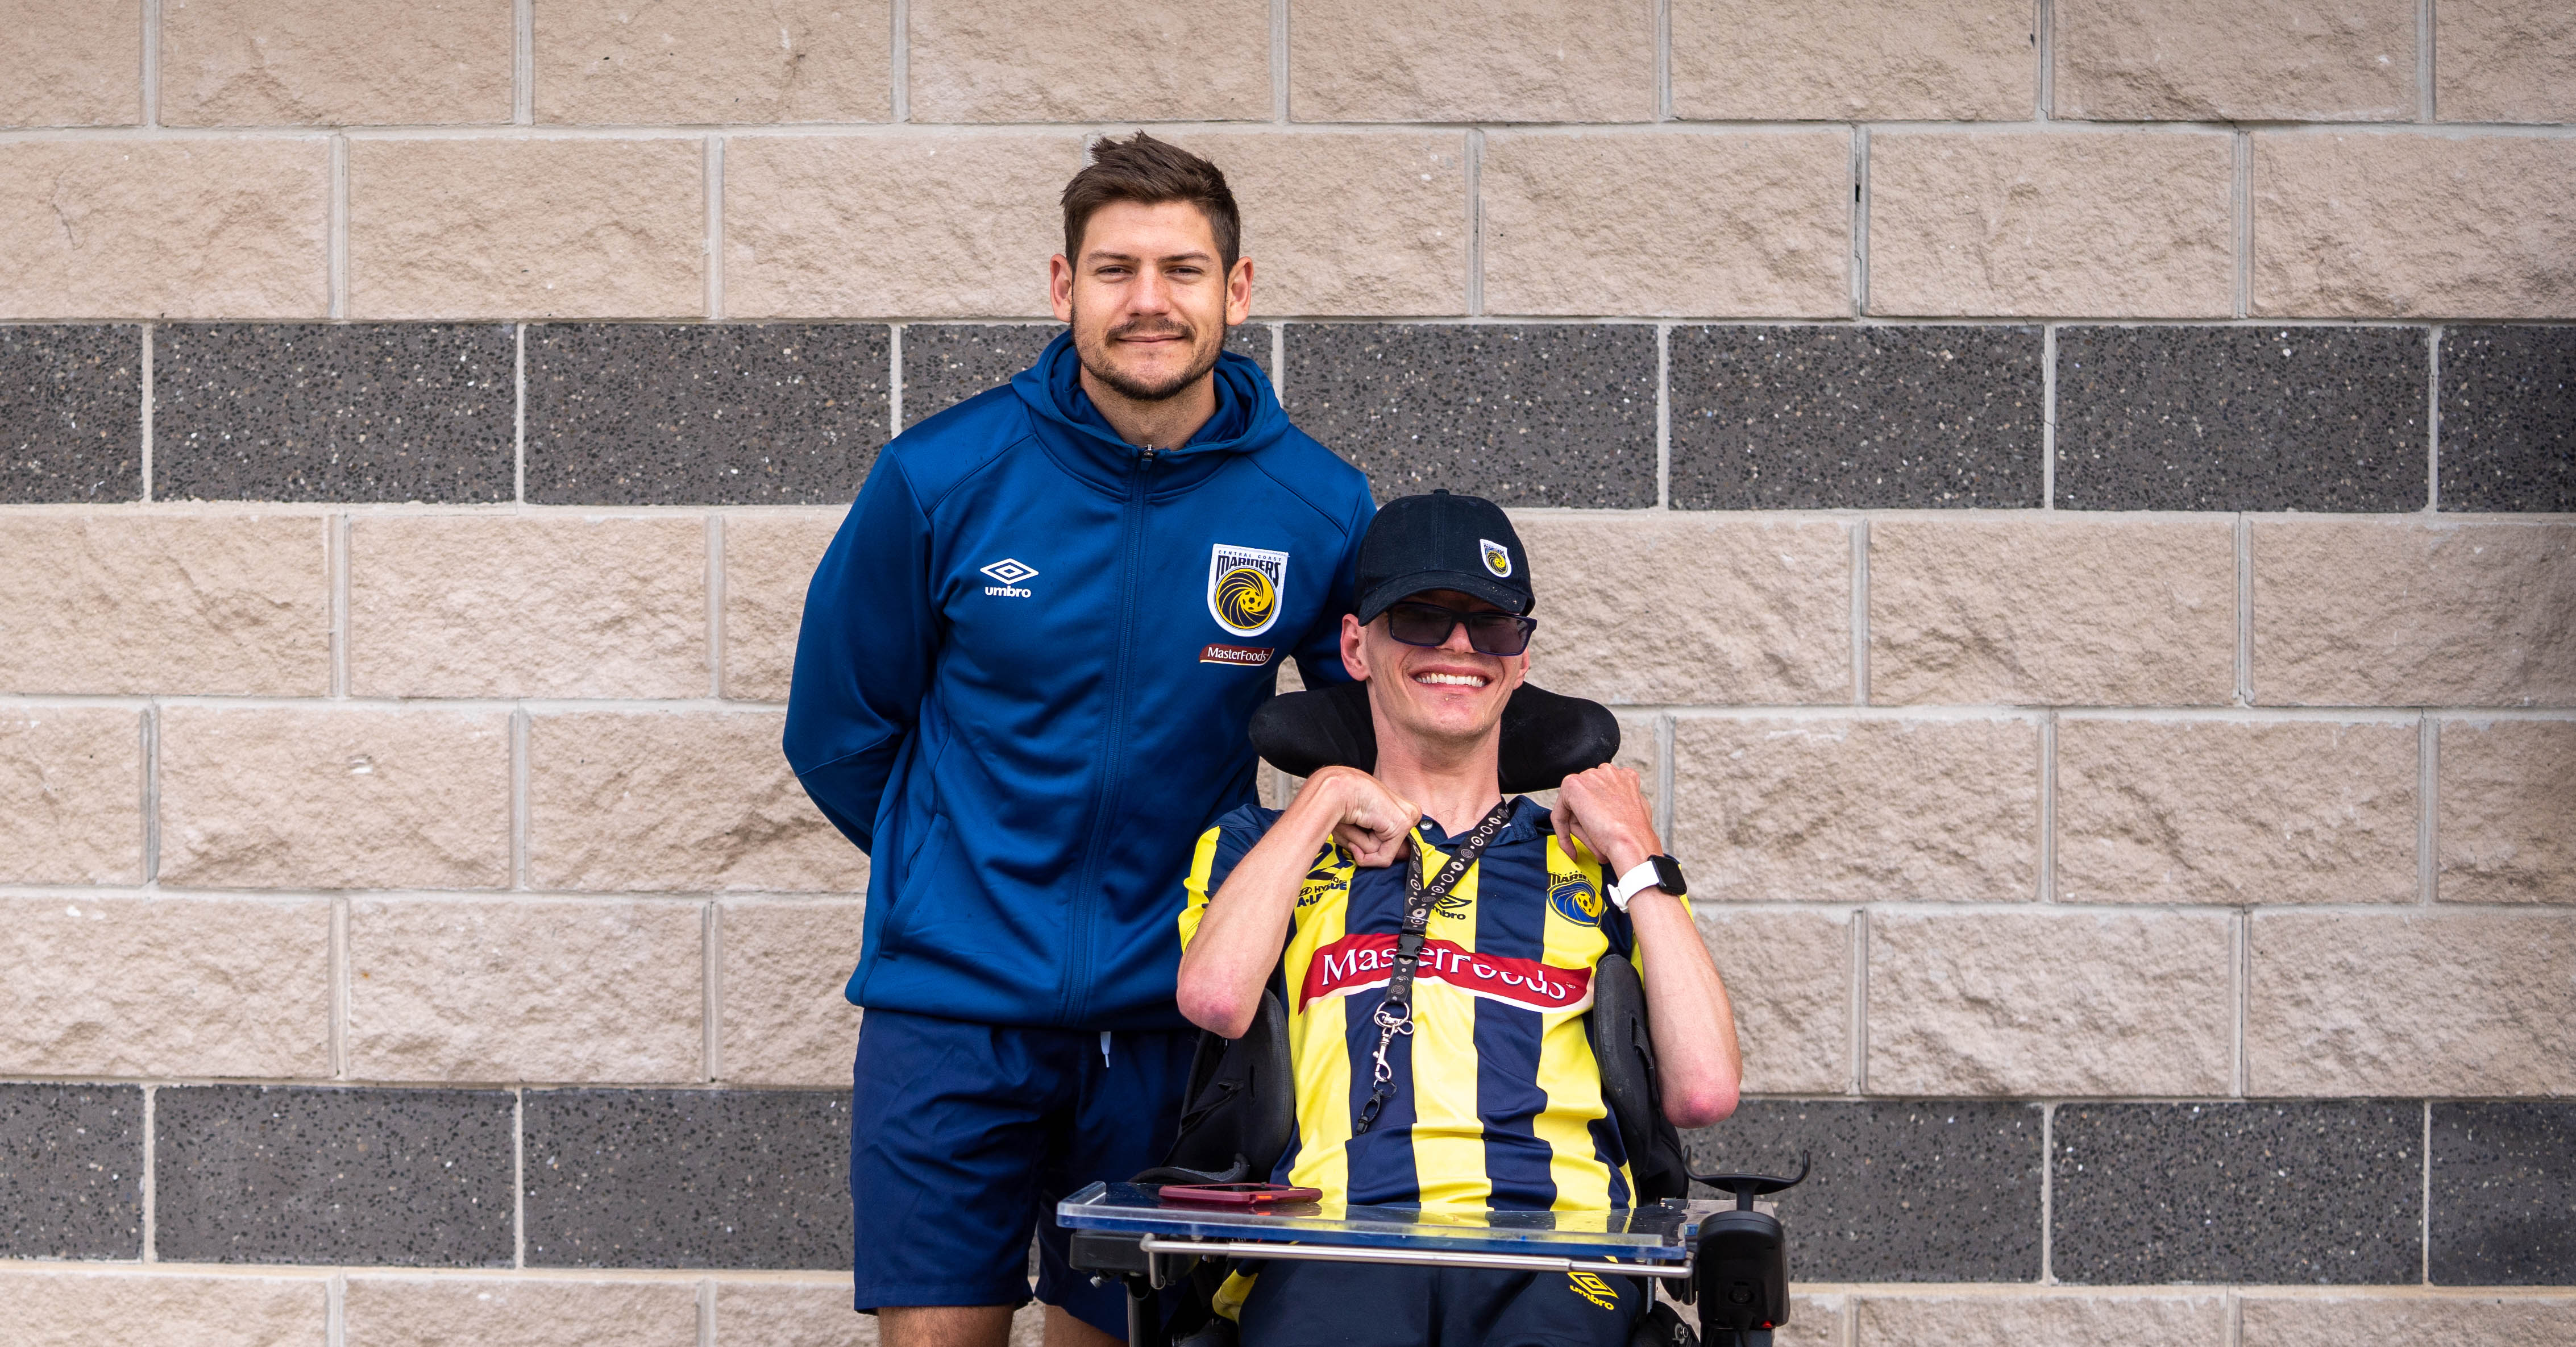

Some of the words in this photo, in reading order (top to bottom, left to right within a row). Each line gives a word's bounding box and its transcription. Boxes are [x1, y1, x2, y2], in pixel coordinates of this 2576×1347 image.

[1215, 555, 1281, 588] MARINERS
[985, 586, 1031, 598] umbro
[1207, 646, 1267, 661] MasterFoods
[1432, 906, 1466, 920] mbro
[1569, 1285, 1614, 1310] umbro
